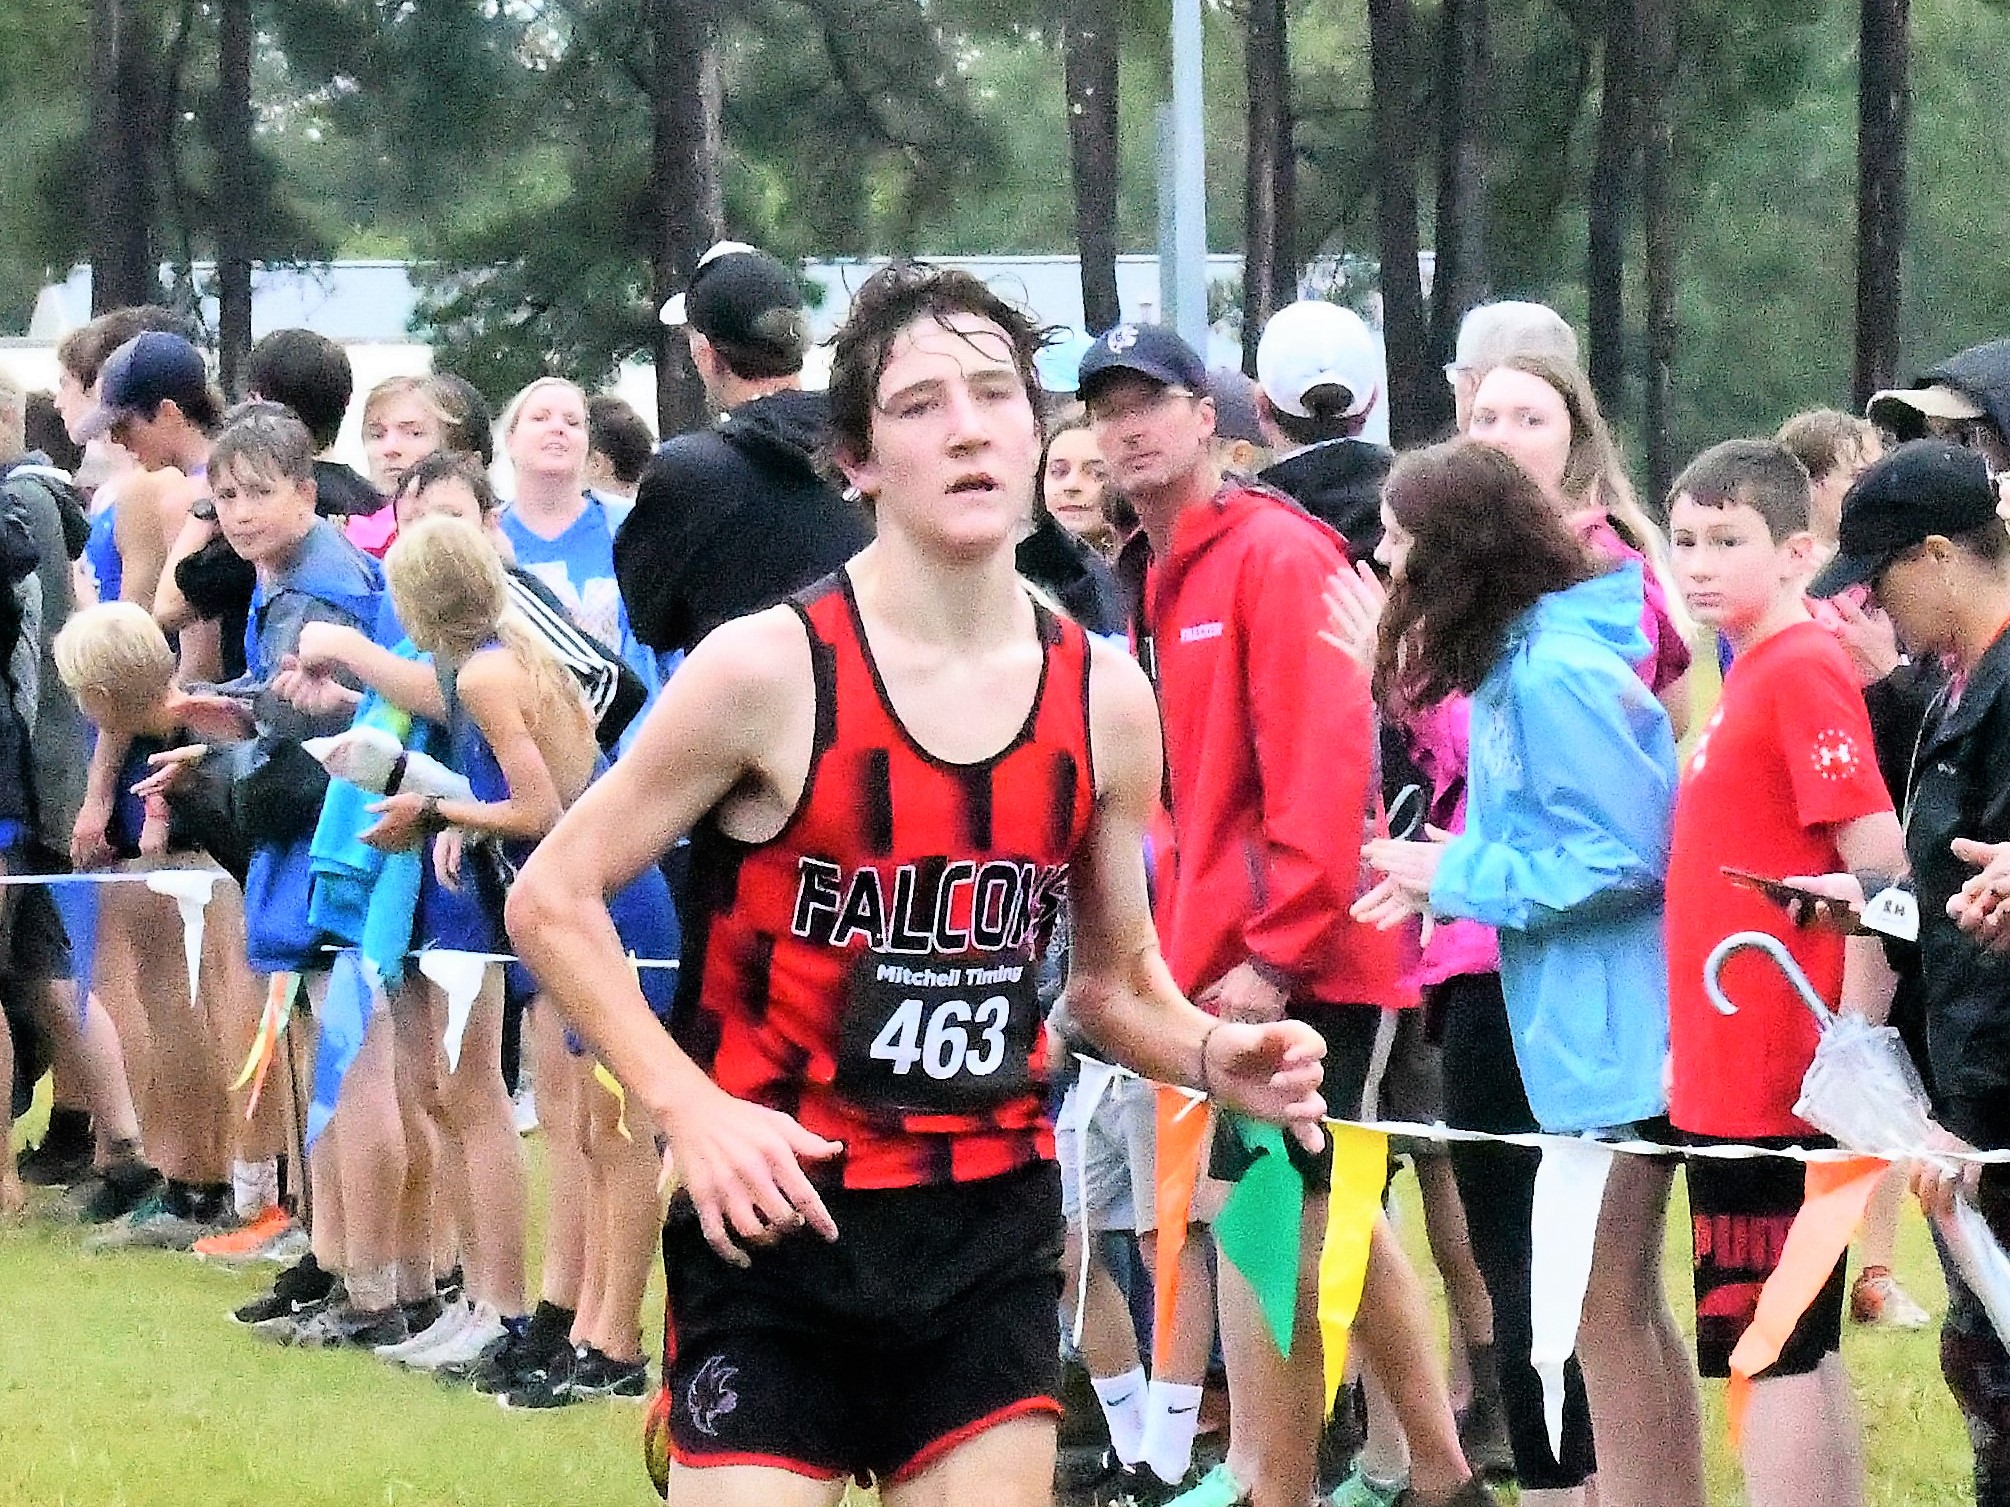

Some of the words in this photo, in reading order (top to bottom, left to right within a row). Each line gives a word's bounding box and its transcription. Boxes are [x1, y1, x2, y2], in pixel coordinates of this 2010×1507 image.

[877, 964, 961, 987] Mitchell
[966, 965, 1024, 986] Timing
[870, 996, 1010, 1079] 463
